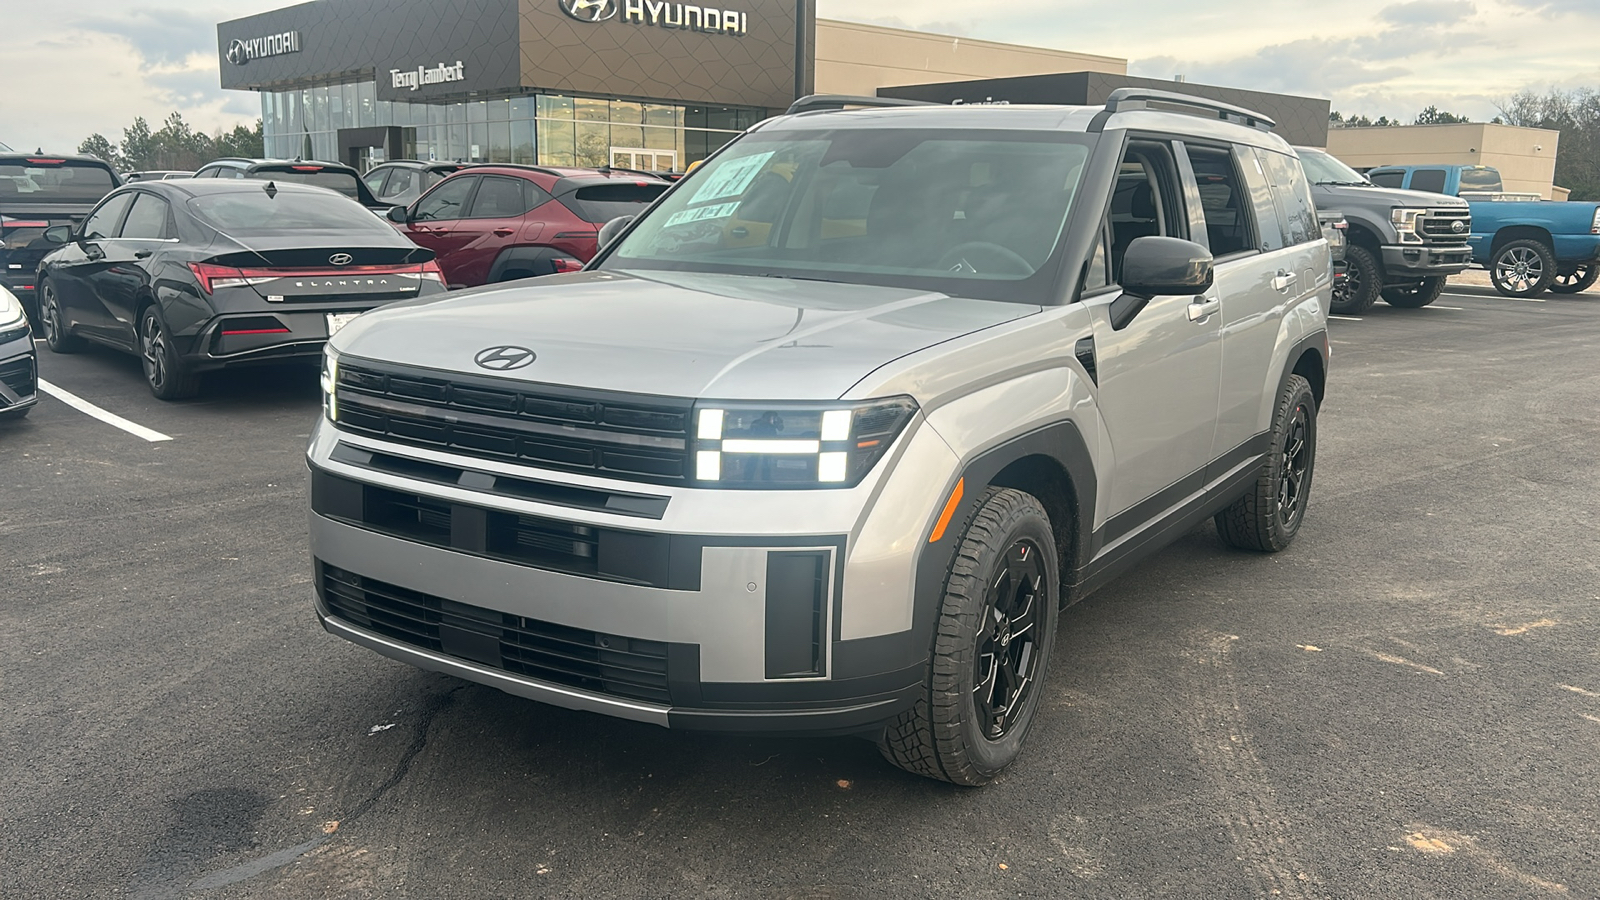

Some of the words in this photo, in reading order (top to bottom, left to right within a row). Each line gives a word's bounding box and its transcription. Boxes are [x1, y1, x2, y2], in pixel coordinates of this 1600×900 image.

[625, 0, 747, 33] HYUNDAI
[245, 31, 299, 59] HYUNDAI
[389, 69, 419, 91] Terry
[418, 61, 464, 85] Lambert
[295, 279, 387, 287] ELANTRA
